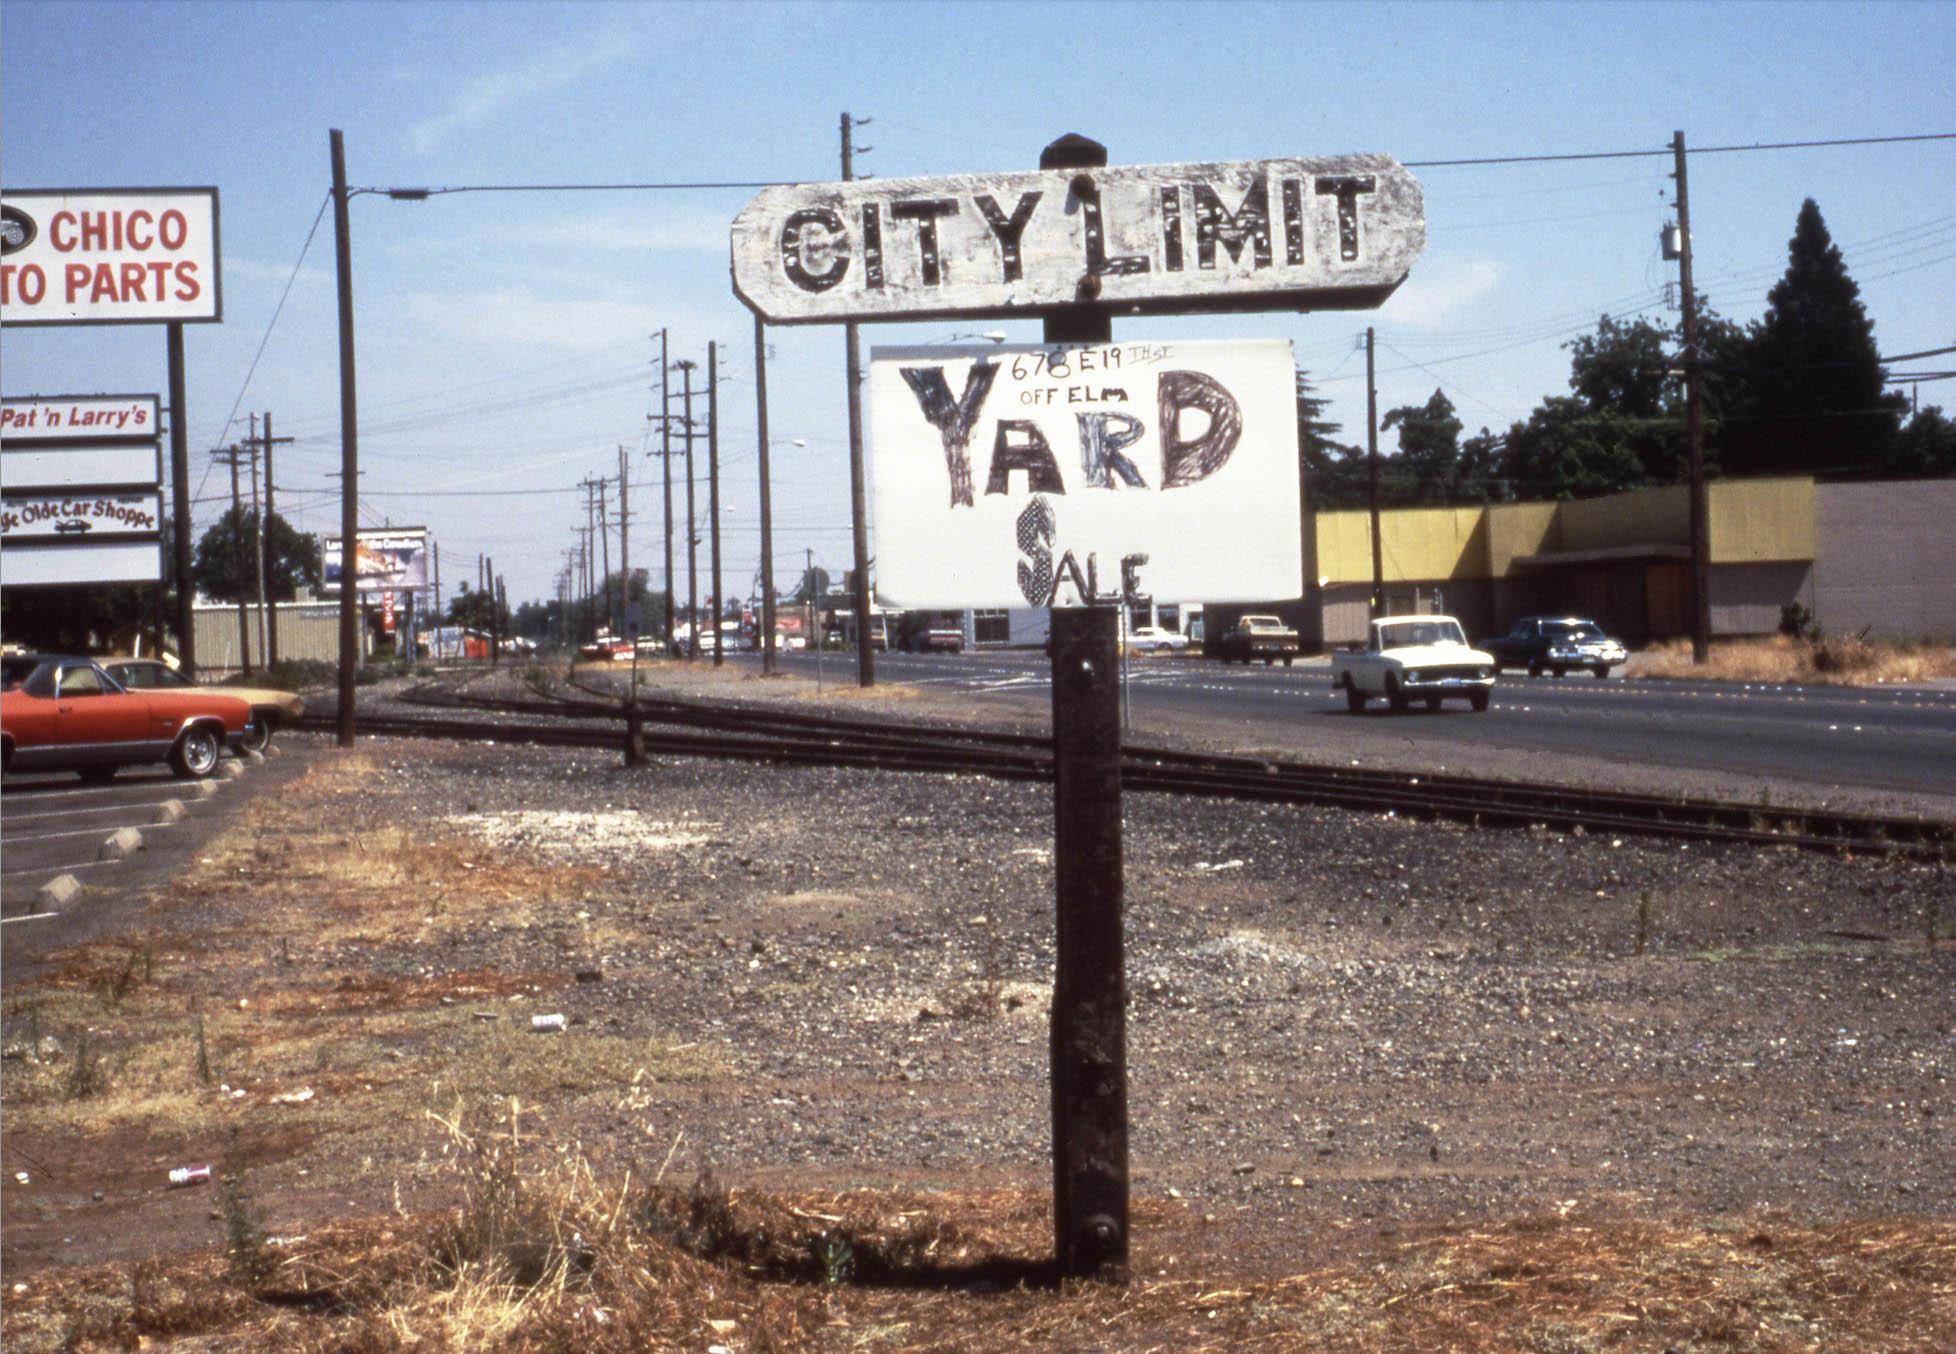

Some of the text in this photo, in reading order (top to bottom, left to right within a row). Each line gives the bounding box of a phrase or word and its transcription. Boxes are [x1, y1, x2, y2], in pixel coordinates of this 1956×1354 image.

[50, 209, 187, 252] CHICO
[782, 175, 1377, 293] CITY LIMIT
[65, 260, 200, 304] PARTS
[1012, 351, 1071, 381] 678
[1, 408, 36, 428] Pat
[68, 405, 147, 429] Larry's
[1020, 386, 1128, 405] OFF ELM
[899, 361, 1243, 509] YARD
[21, 501, 59, 524] Olde
[61, 501, 91, 517] Car
[93, 501, 154, 529] Shoppe
[1016, 495, 1152, 608] SALE
